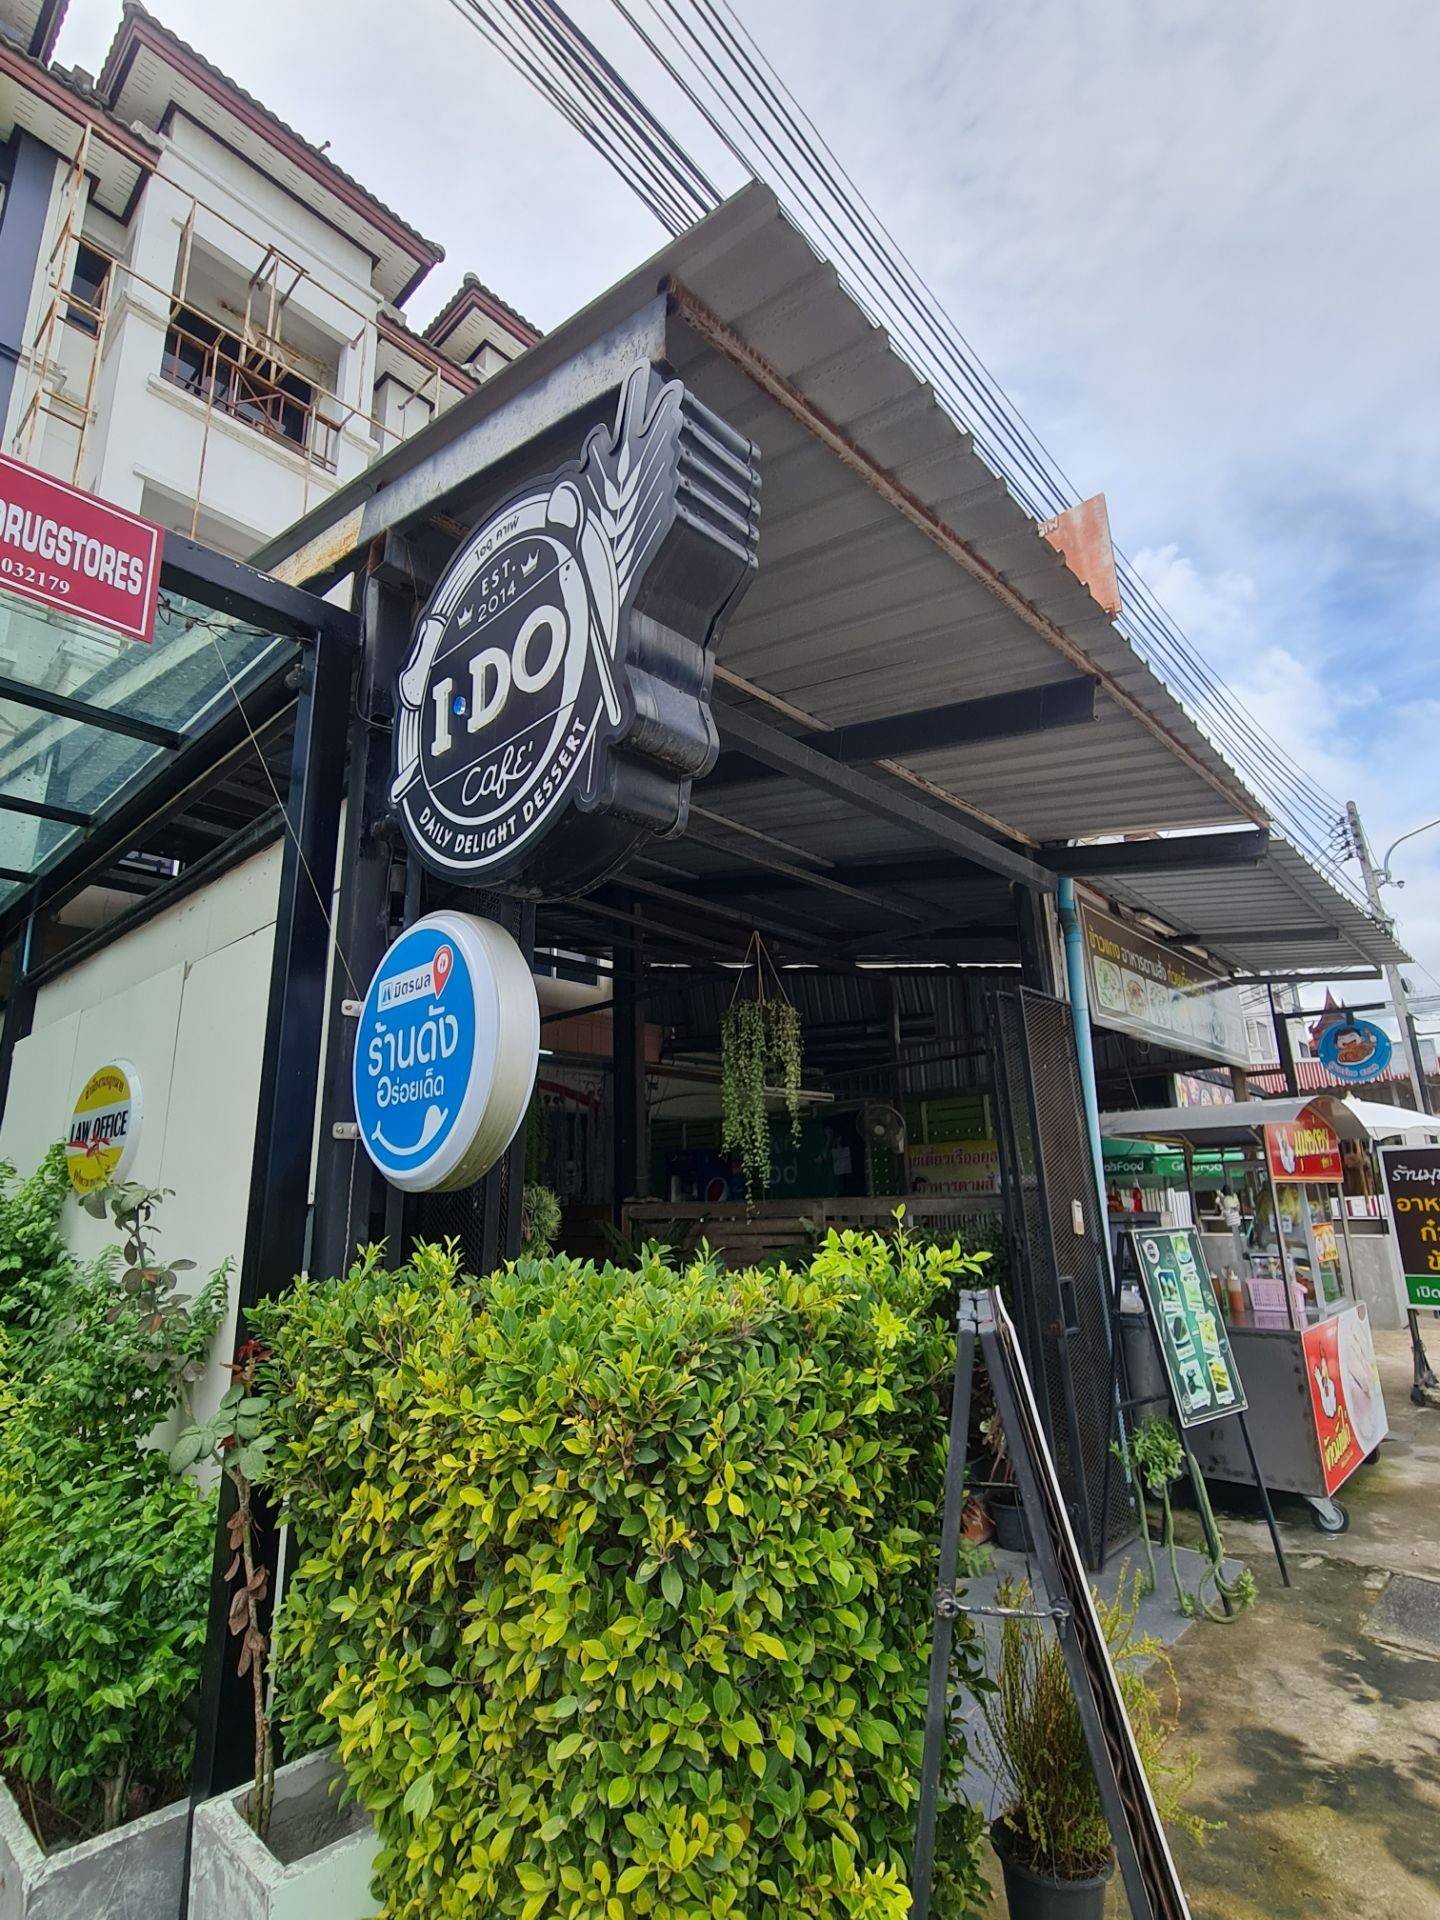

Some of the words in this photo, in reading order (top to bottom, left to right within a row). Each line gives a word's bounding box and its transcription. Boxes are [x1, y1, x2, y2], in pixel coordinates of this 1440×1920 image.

[1, 558, 70, 594] 032179
[481, 559, 516, 597] EST.
[477, 580, 516, 623] 2014
[419, 806, 453, 848] DAILY
[454, 814, 517, 854] DELIGHT
[522, 717, 586, 823] DESSERT
[394, 973, 431, 999] มิตรผล
[367, 1004, 459, 1077] ร้านดัง
[377, 1067, 444, 1108] อร่อยเด็ด
[70, 1119, 92, 1143] LAW
[92, 1109, 129, 1139] OFFICE
[1392, 1165, 1440, 1187] ร้านมุ
[1397, 1197, 1440, 1212] อาห
[1420, 1219, 1440, 1242] ก๋
